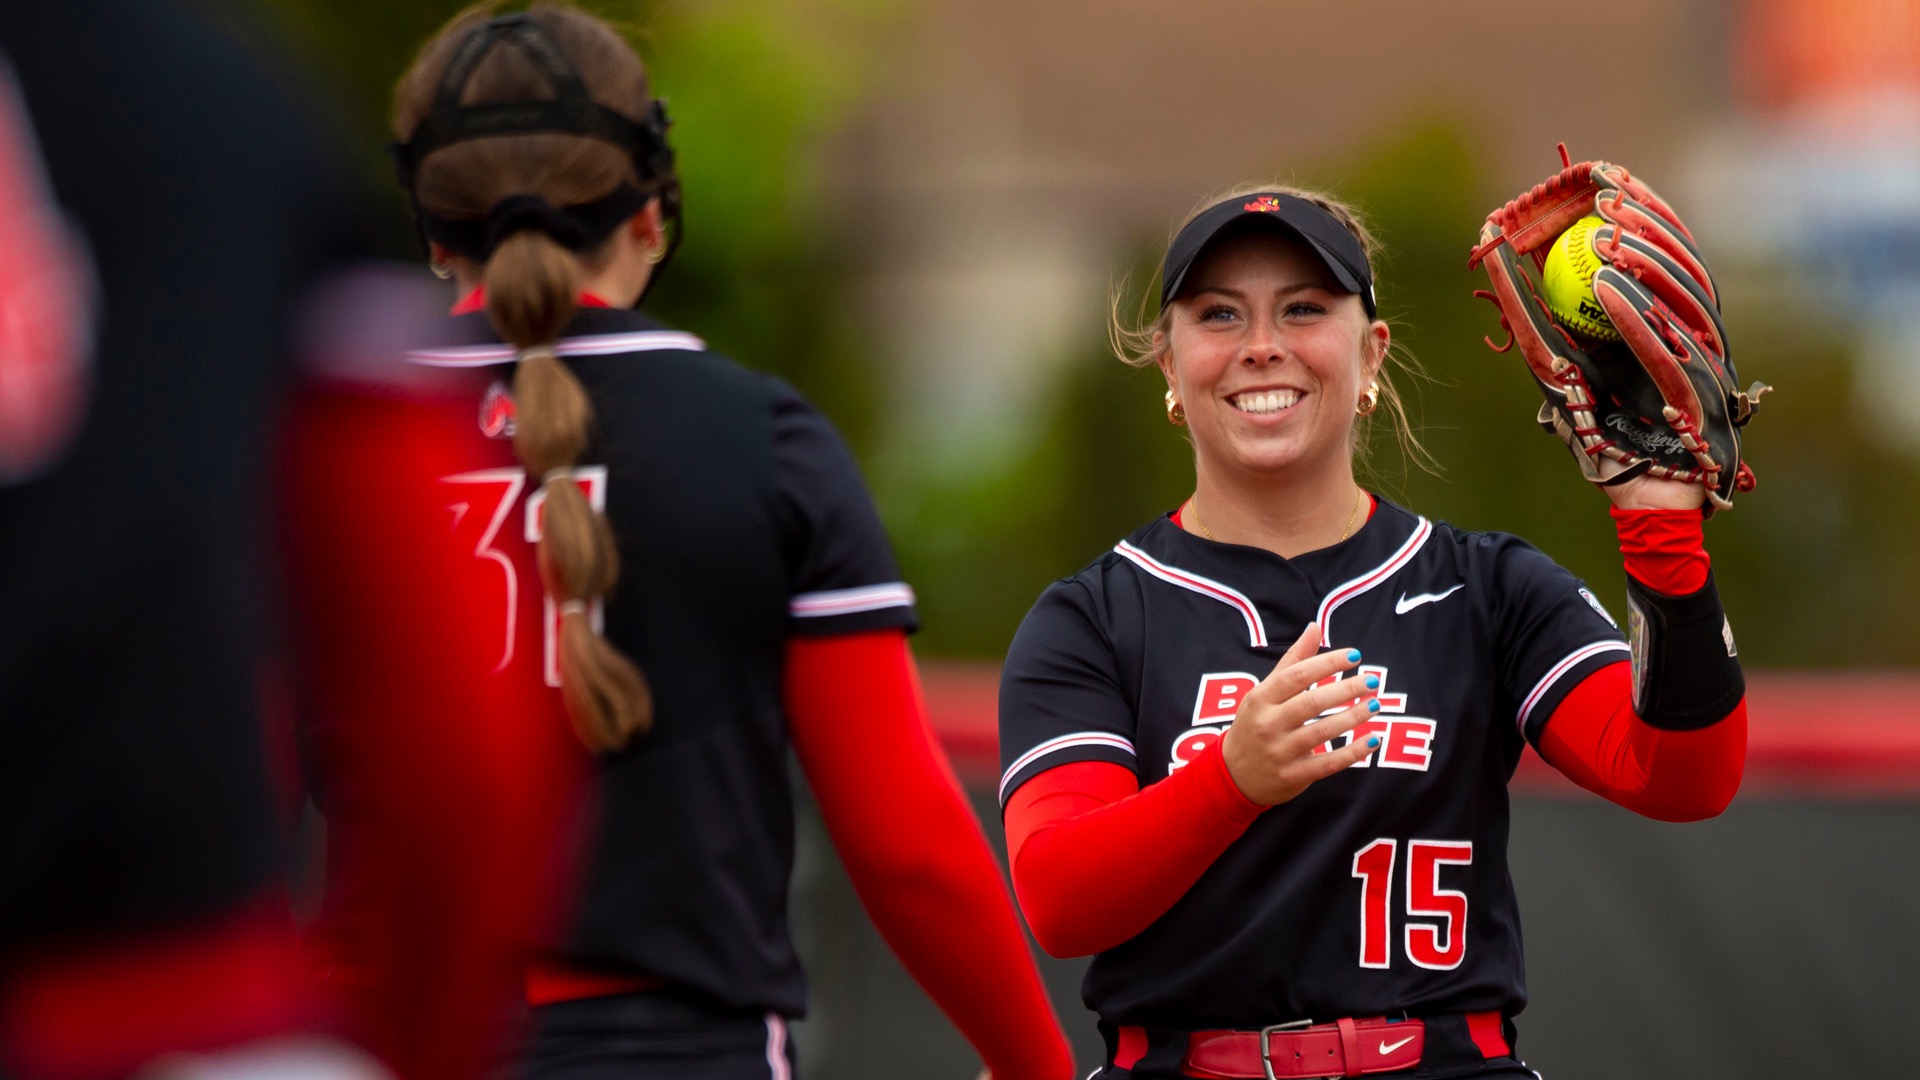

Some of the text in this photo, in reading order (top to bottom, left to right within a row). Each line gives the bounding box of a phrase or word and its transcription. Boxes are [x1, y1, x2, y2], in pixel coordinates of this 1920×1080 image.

[1192, 665, 1408, 726] BL
[1168, 715, 1437, 776] STE
[1352, 838, 1473, 970] 15
